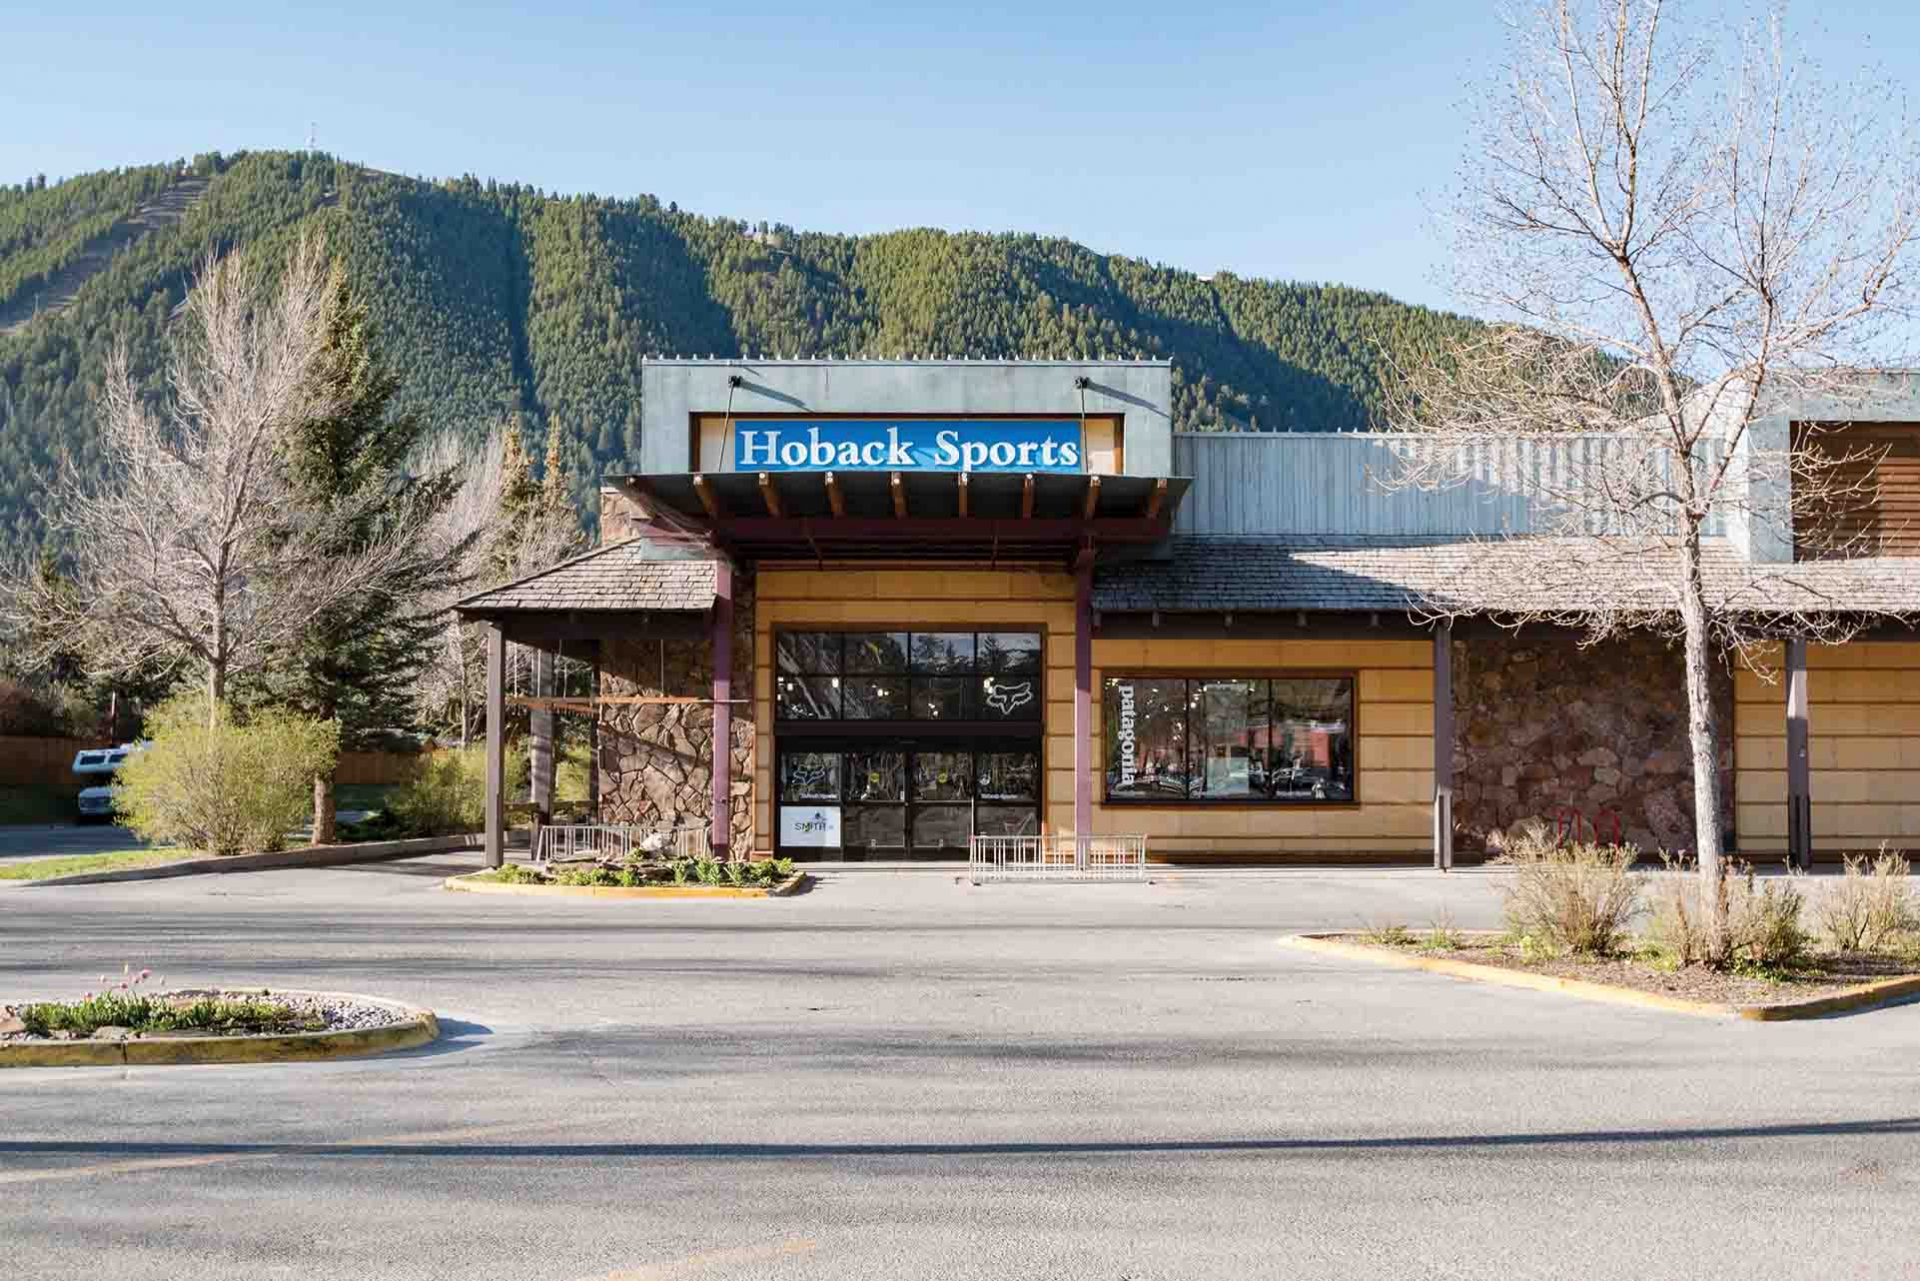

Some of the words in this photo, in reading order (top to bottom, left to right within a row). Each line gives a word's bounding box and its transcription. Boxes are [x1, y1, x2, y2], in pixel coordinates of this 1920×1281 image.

[739, 426, 916, 467] Hoback
[934, 429, 1079, 472] Sports
[1118, 685, 1136, 785] patagonia
